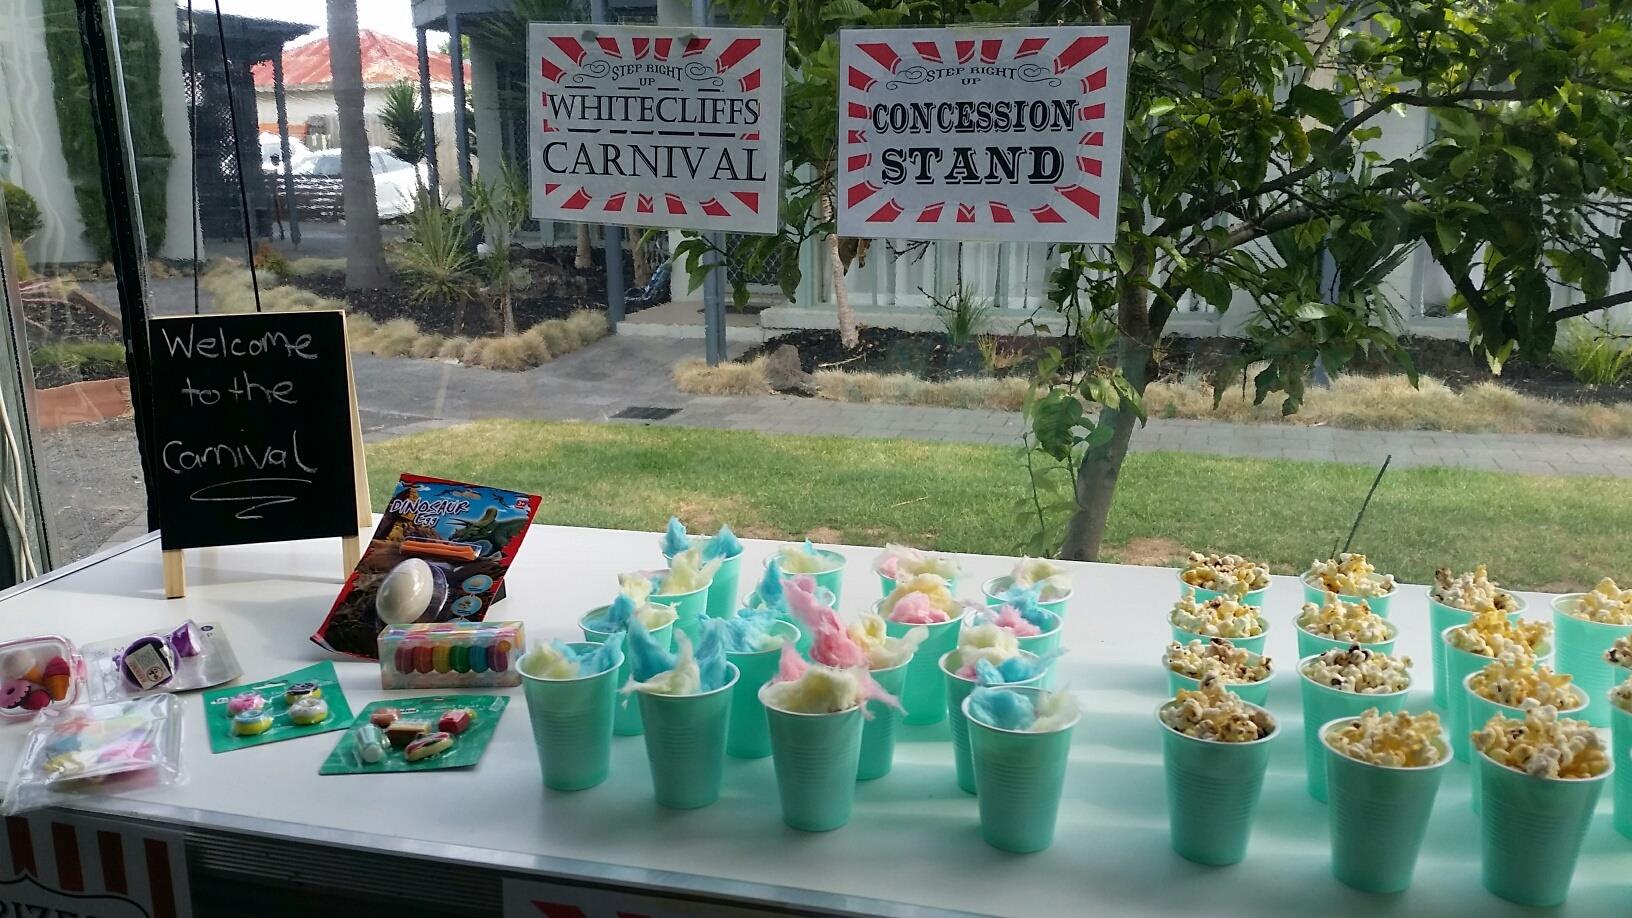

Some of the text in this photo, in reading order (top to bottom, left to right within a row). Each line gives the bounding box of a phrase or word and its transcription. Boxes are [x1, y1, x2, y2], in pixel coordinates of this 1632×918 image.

[611, 63, 683, 81] STEP RIGHT
[639, 77, 656, 87] UP
[926, 66, 1017, 82] STEP RIGHT
[547, 94, 760, 125] WHITECLIFFS
[872, 99, 1080, 134] CONCESSION
[542, 141, 767, 182] CARNIVAL
[881, 145, 1065, 185] STAND
[161, 323, 318, 359] Welcome
[181, 370, 298, 407] to the
[162, 429, 318, 474] Carnival
[389, 497, 471, 515] DINOSAUR
